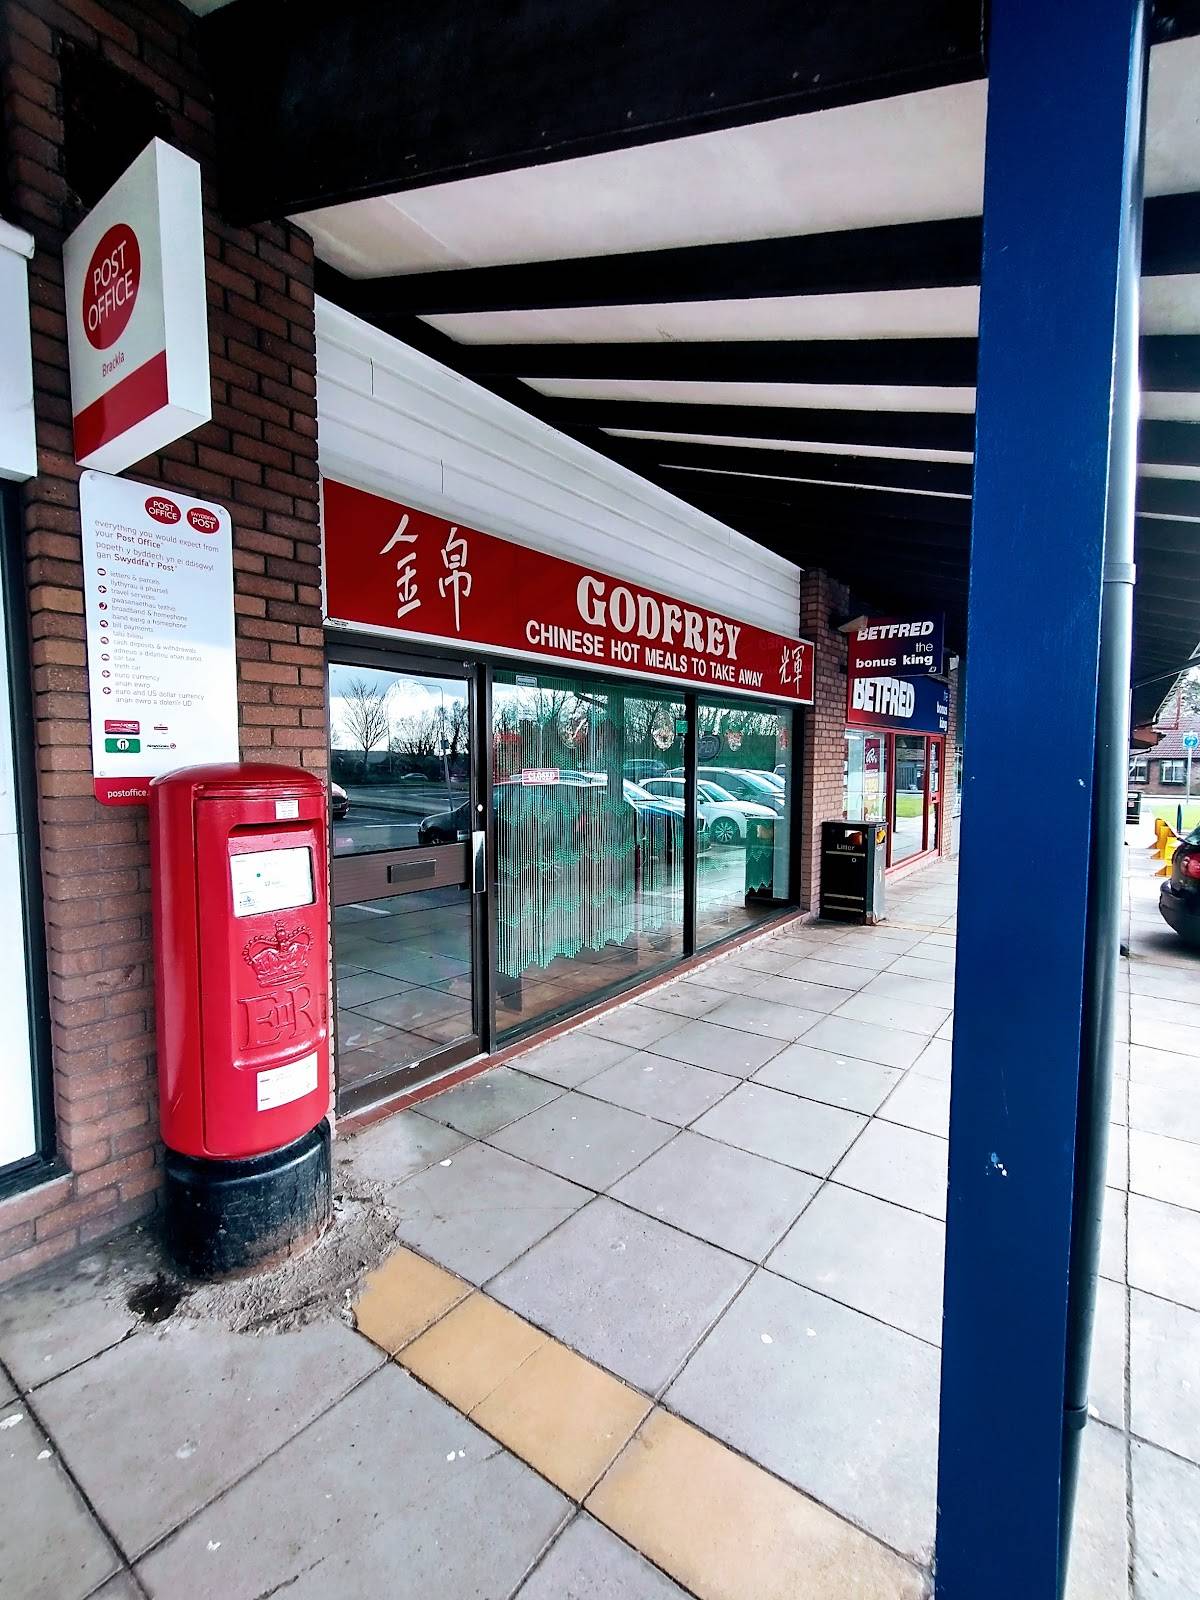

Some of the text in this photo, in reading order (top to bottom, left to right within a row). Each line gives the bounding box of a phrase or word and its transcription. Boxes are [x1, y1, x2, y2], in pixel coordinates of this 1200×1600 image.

[93, 240, 127, 296] POST
[88, 268, 134, 332] OFFICE
[102, 351, 125, 377] Brackla
[148, 506, 178, 521] OFFICE
[153, 500, 175, 512] POST
[94, 520, 137, 535] everything
[139, 530, 153, 538] you
[155, 533, 177, 543] would
[192, 517, 216, 530] POST
[95, 529, 113, 538] your
[116, 532, 135, 543] Post
[576, 575, 741, 661] GODFREY
[857, 621, 934, 641] BETFRED
[525, 619, 763, 688] CHINESE HOT MEALS TO TAKE AWAY
[915, 642, 934, 653] the
[855, 654, 933, 668] bonus king
[852, 677, 915, 718] BETFRED
